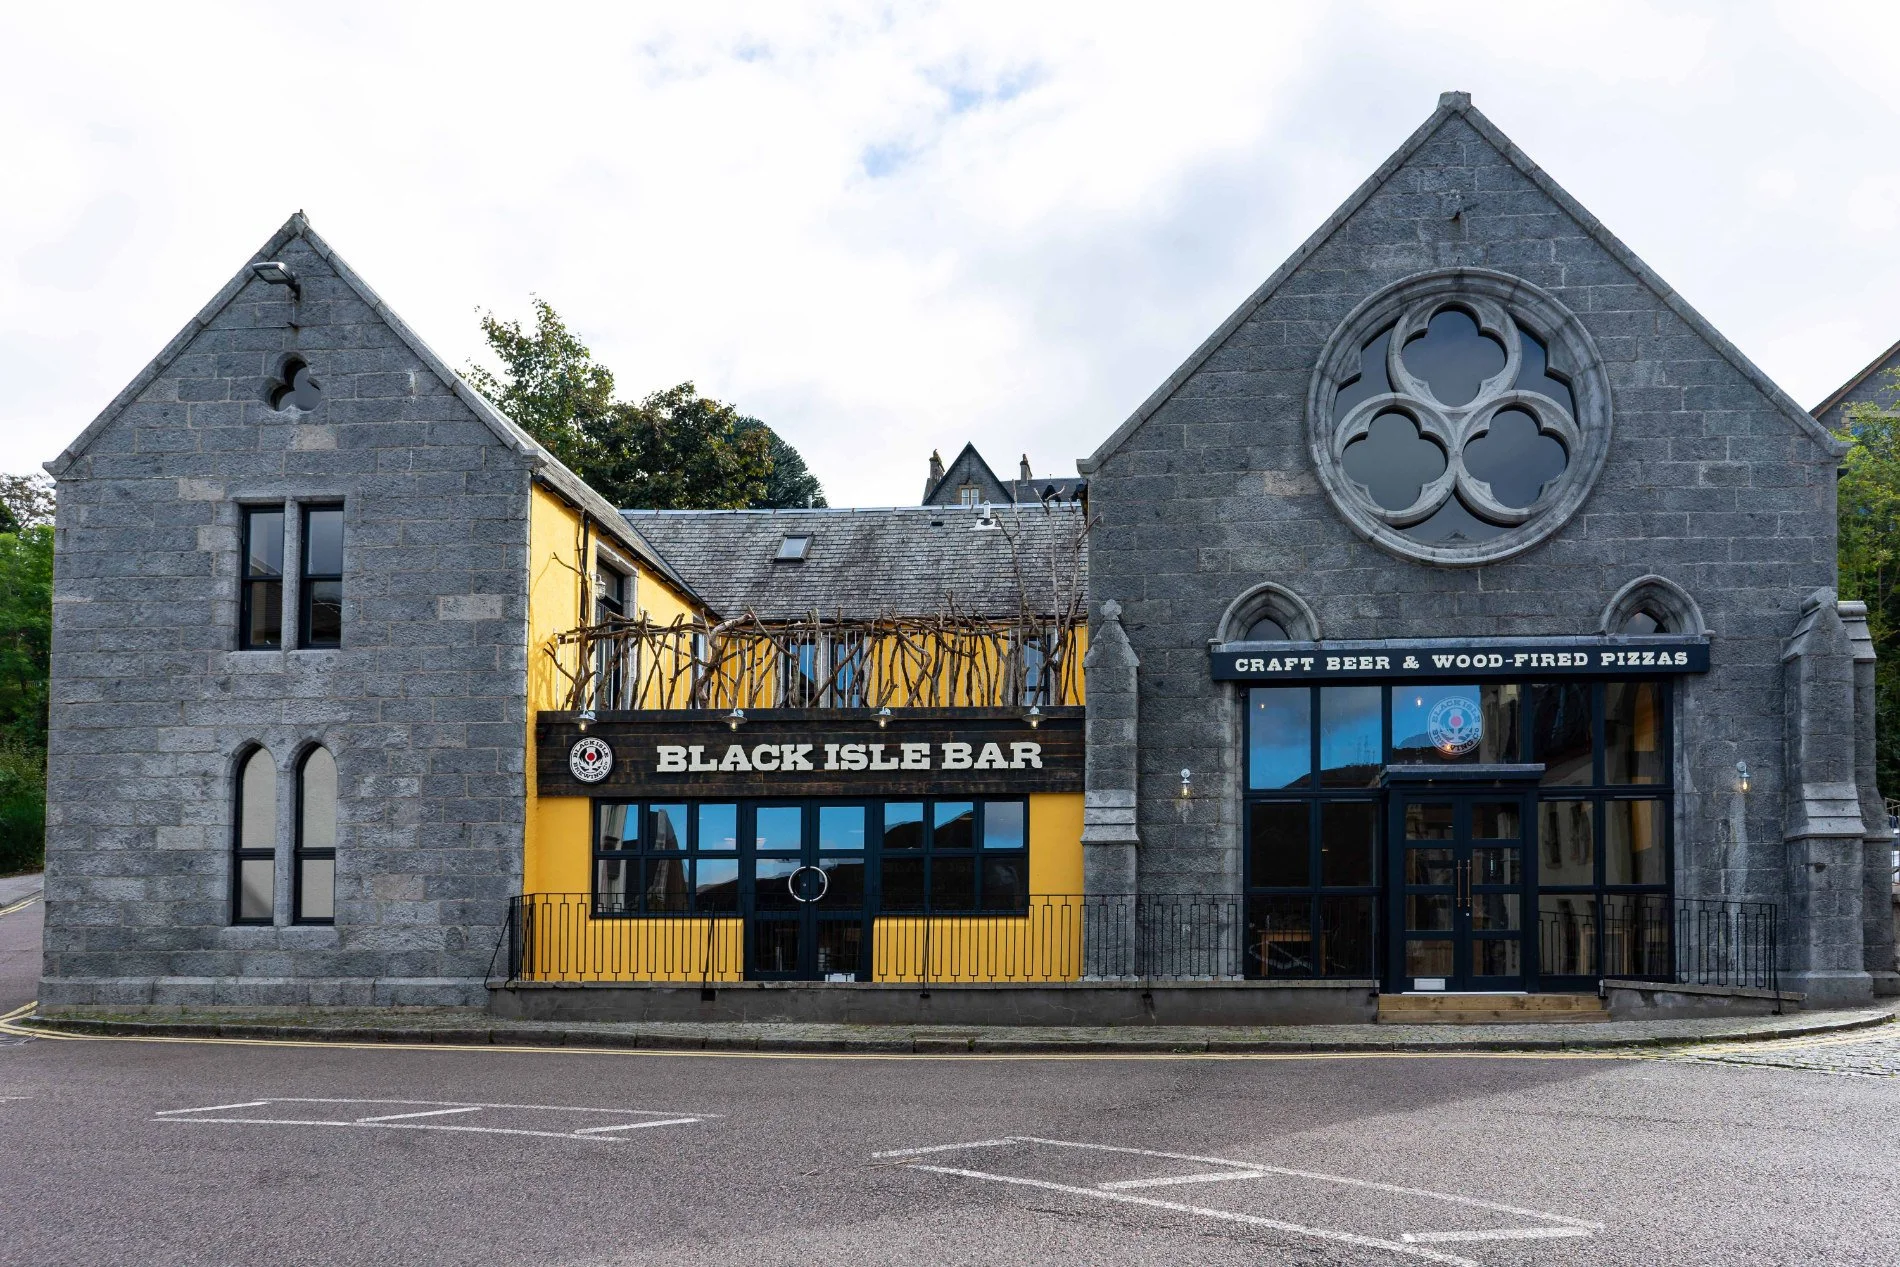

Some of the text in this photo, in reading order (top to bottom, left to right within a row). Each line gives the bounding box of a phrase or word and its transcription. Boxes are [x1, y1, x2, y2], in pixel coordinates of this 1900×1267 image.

[1234, 650, 1688, 673] CRAFT BEER & WOOD-FIRED PIZZAS
[1432, 700, 1481, 723] BLACK ISLE
[573, 740, 610, 758] BLACK ISLE
[656, 742, 1043, 773] BLACK ISLE BAR
[573, 762, 603, 779] BREWING
